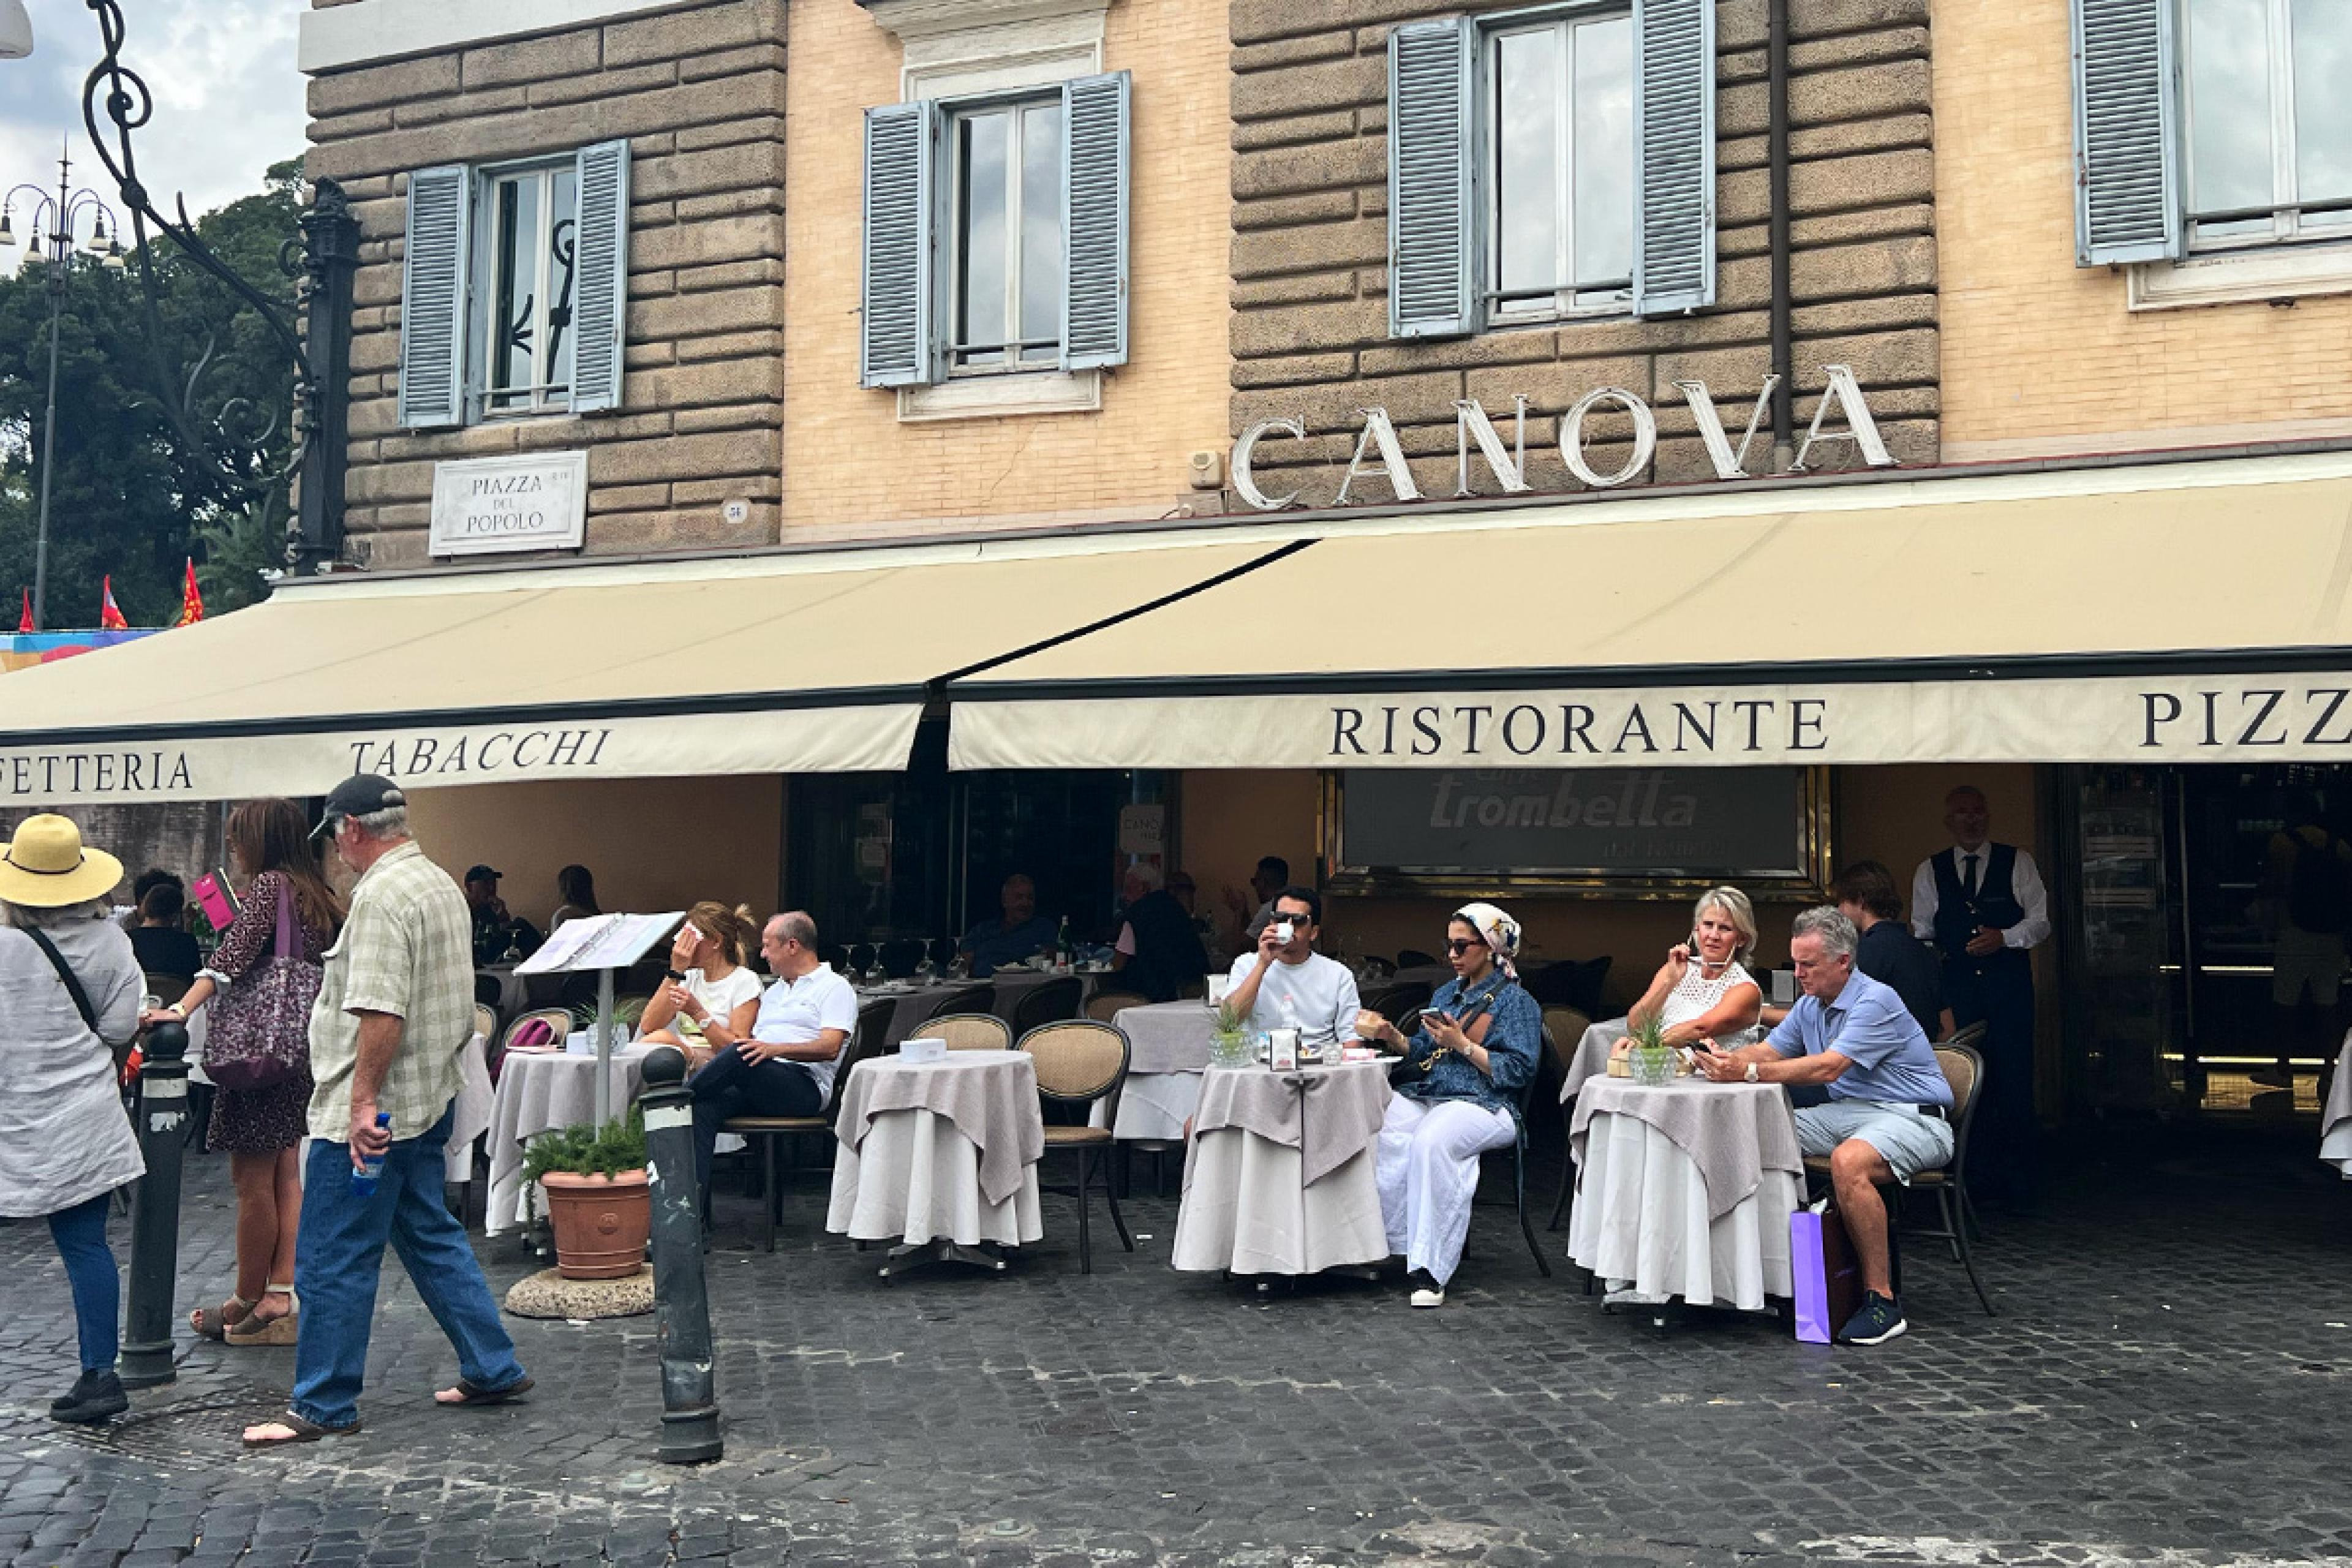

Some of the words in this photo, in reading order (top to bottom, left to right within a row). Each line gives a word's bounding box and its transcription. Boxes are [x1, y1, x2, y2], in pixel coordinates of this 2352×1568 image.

[1231, 363, 1901, 511] CANOVA
[472, 475, 542, 496] PIAZZA
[493, 497, 515, 510] DEL
[466, 511, 544, 533] POPOLO
[1328, 698, 1829, 756] RISTORANTE
[2138, 689, 2352, 747] PIZZ
[350, 728, 614, 777] TABACCHI
[1430, 770, 1699, 829] trombetta
